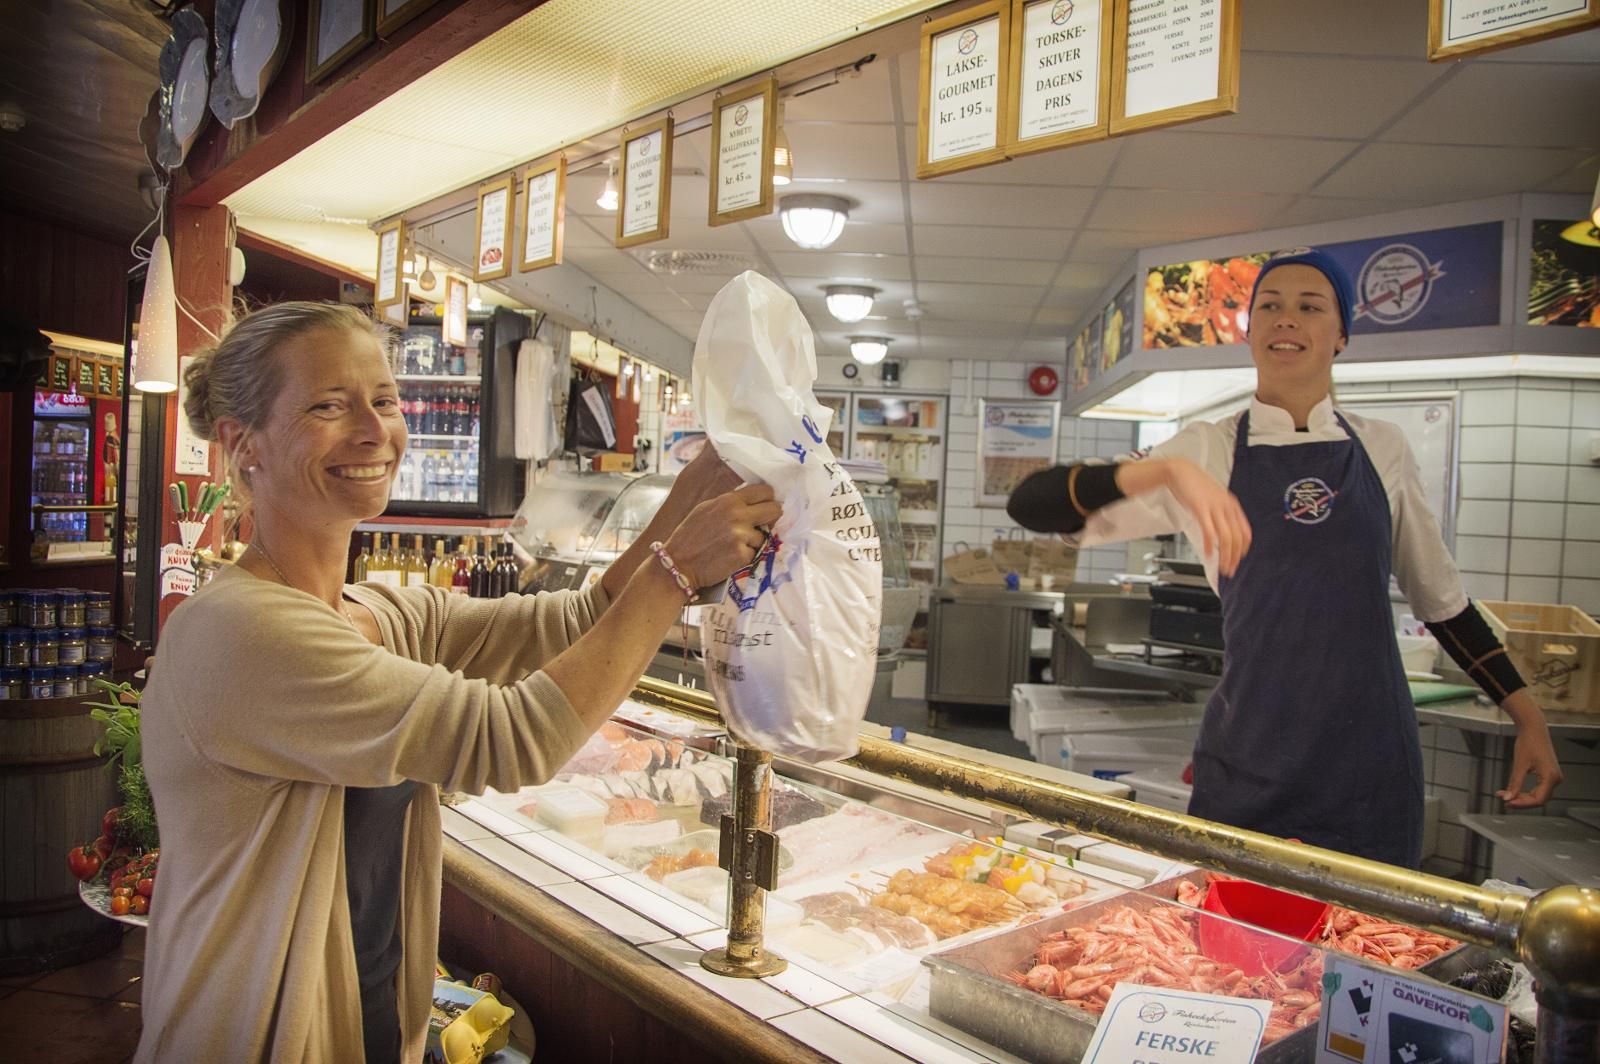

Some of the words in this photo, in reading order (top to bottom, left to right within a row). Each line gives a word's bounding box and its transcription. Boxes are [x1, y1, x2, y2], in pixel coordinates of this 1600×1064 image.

[1507, 2, 1519, 10] AV
[1036, 25, 1087, 49] TORSKE-
[946, 54, 988, 77] LAKSE-
[1038, 48, 1081, 69] SKIVER
[938, 74, 996, 101] GOURMET
[1036, 70, 1083, 92] DAGENS
[939, 110, 956, 125] kr.
[959, 101, 983, 119] 195
[1044, 93, 1072, 111] PRIS
[832, 502, 865, 521] RØY
[168, 556, 189, 566] KNIV
[170, 581, 190, 592] KNIV
[1392, 987, 1471, 1023] GAVEKOR
[1135, 1030, 1220, 1057] FERSKE
